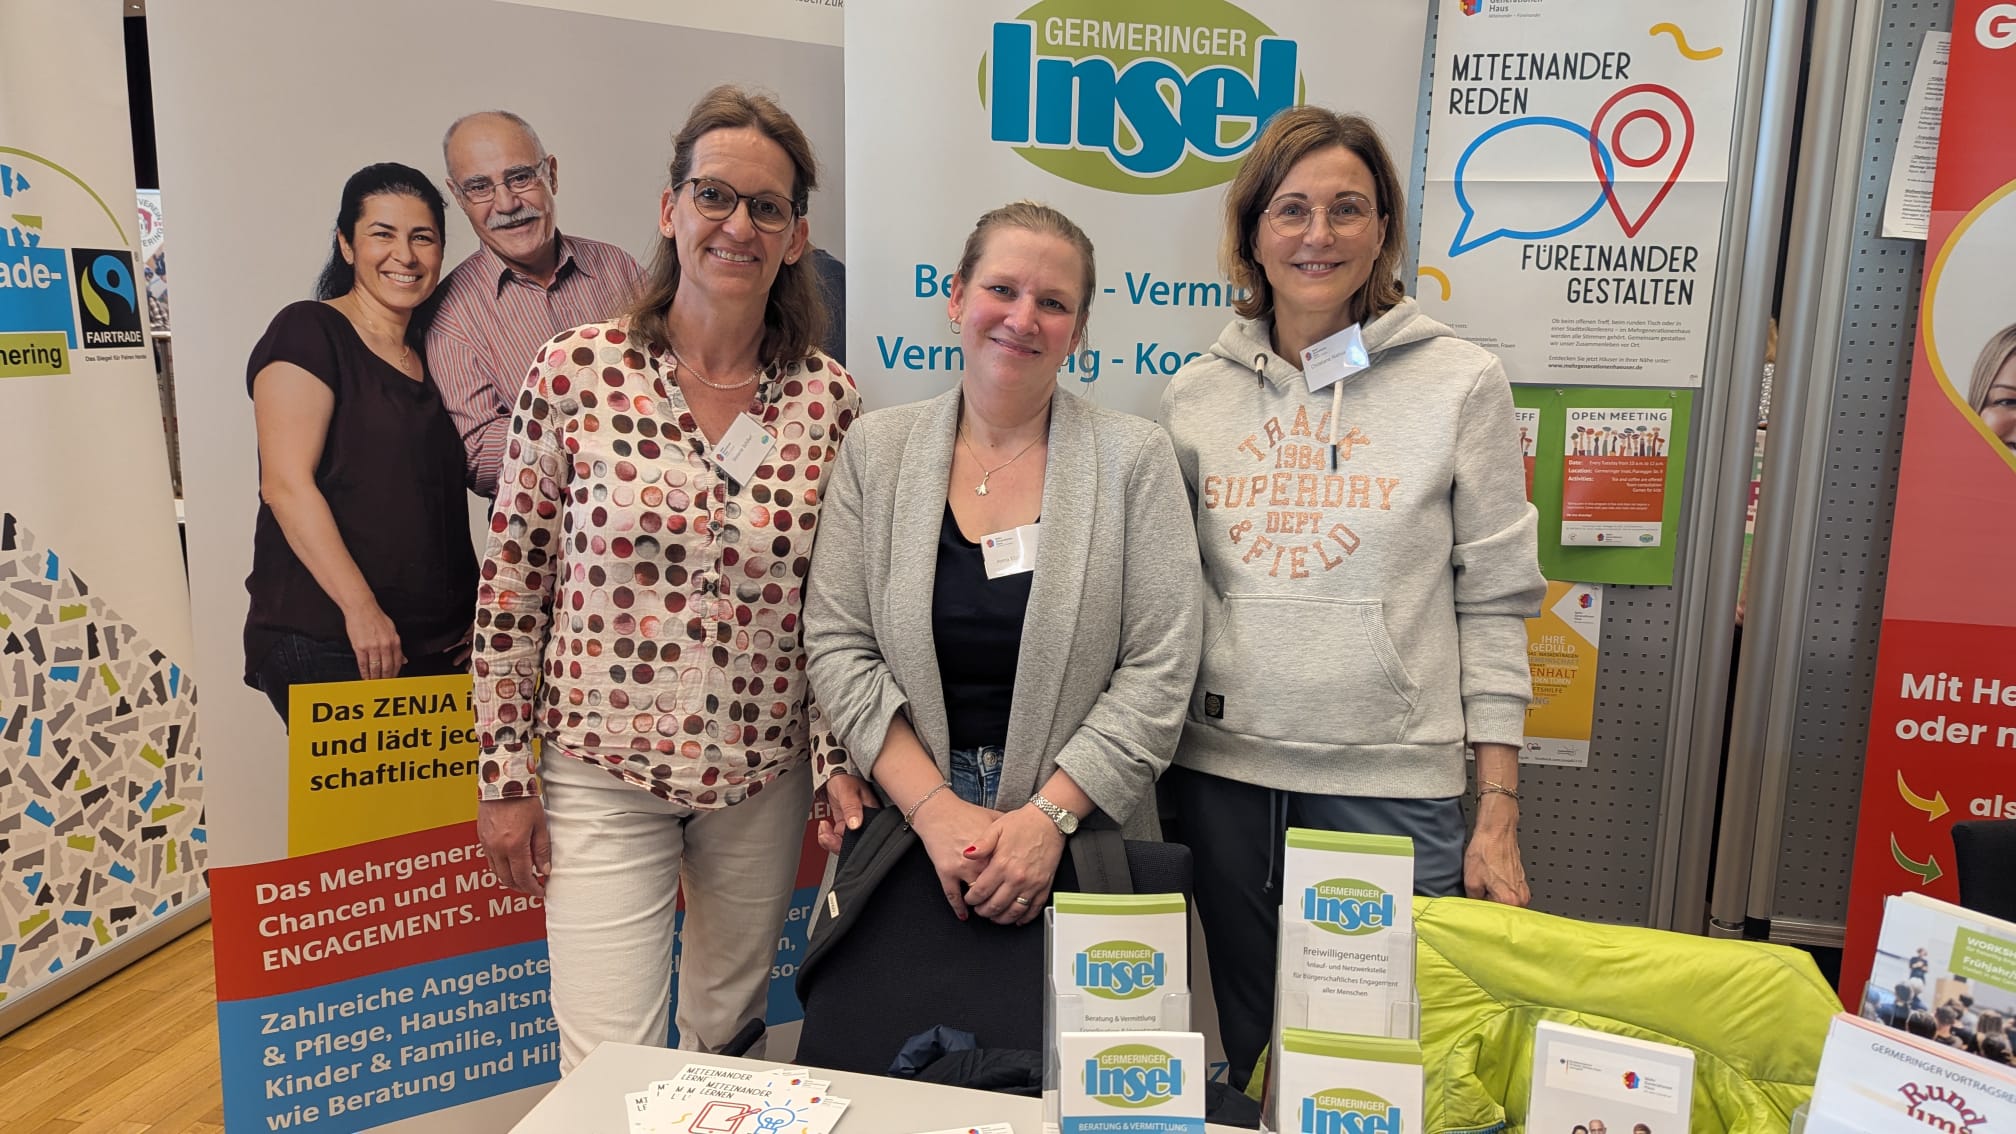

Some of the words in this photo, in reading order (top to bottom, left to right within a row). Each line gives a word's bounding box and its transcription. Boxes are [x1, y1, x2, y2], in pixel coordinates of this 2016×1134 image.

[1489, 4, 1509, 12] Haus
[1045, 17, 1247, 56] GERMERINGER
[1452, 52, 1631, 81] MITEINANDER
[991, 22, 1297, 174] Insel
[1449, 87, 1528, 115] REDEN
[1521, 244, 1698, 273] FÜREINANDER
[1567, 277, 1694, 305] GESTALTEN
[87, 330, 142, 345] FAIRTRADE
[1571, 412, 1605, 421] OPEN
[1610, 412, 1667, 421] MEETING
[1275, 444, 1326, 470] 1984
[1204, 472, 1400, 510] SUPERDRY
[1265, 511, 1323, 534] DEPT
[1242, 523, 1361, 579] FIELD
[1531, 643, 1575, 654] GEDULD
[1541, 635, 1566, 644] IHRE
[1901, 672, 1963, 702] Mit
[312, 702, 364, 723] Das
[374, 693, 457, 718] ZENJA
[312, 732, 367, 757] und
[378, 727, 432, 752] lädt
[1895, 716, 1988, 745] oder
[310, 758, 479, 791] schaftlichen
[256, 879, 310, 905] Das
[1319, 885, 1379, 898] GERMERINGER
[258, 897, 385, 938] Chancen
[394, 877, 446, 908] und
[1304, 888, 1393, 930] Insel
[262, 904, 481, 971] ENGAGEMENTS.
[1091, 950, 1150, 959] GERMERINGER
[1076, 953, 1165, 995] Insel
[1303, 972, 1358, 984] Bürgerschaftliches
[1342, 965, 1386, 974] Netzwerkstelle
[261, 986, 414, 1035] Zahlreiche
[422, 958, 550, 999] Angebote
[262, 1046, 286, 1066] &
[295, 1024, 392, 1063] Pflege,
[401, 988, 551, 1034] Haushaltsn
[1085, 1015, 1113, 1023] Beratung
[1120, 1015, 1156, 1023] Vermittlung
[266, 1061, 363, 1099] Kinder
[370, 1053, 391, 1074] &
[401, 1028, 502, 1066] Familie,
[1101, 1055, 1166, 1064] GERMERINGER
[1871, 1042, 1943, 1076] GERMERINGER
[687, 1067, 752, 1081] MITEINANDER
[1086, 1059, 1182, 1102] Insel
[267, 1104, 319, 1130] wie
[328, 1071, 456, 1117] Beratung
[465, 1052, 513, 1081] und
[699, 1088, 733, 1099] LERNEN
[706, 1082, 773, 1097] MITEINANDER
[1318, 1095, 1385, 1112] GERMERINGER
[1078, 1123, 1123, 1131] BERATUNG
[1122, 1123, 1129, 1131] &
[1130, 1123, 1188, 1132] VERMITTLUNG
[1302, 1098, 1400, 1134] Insel
